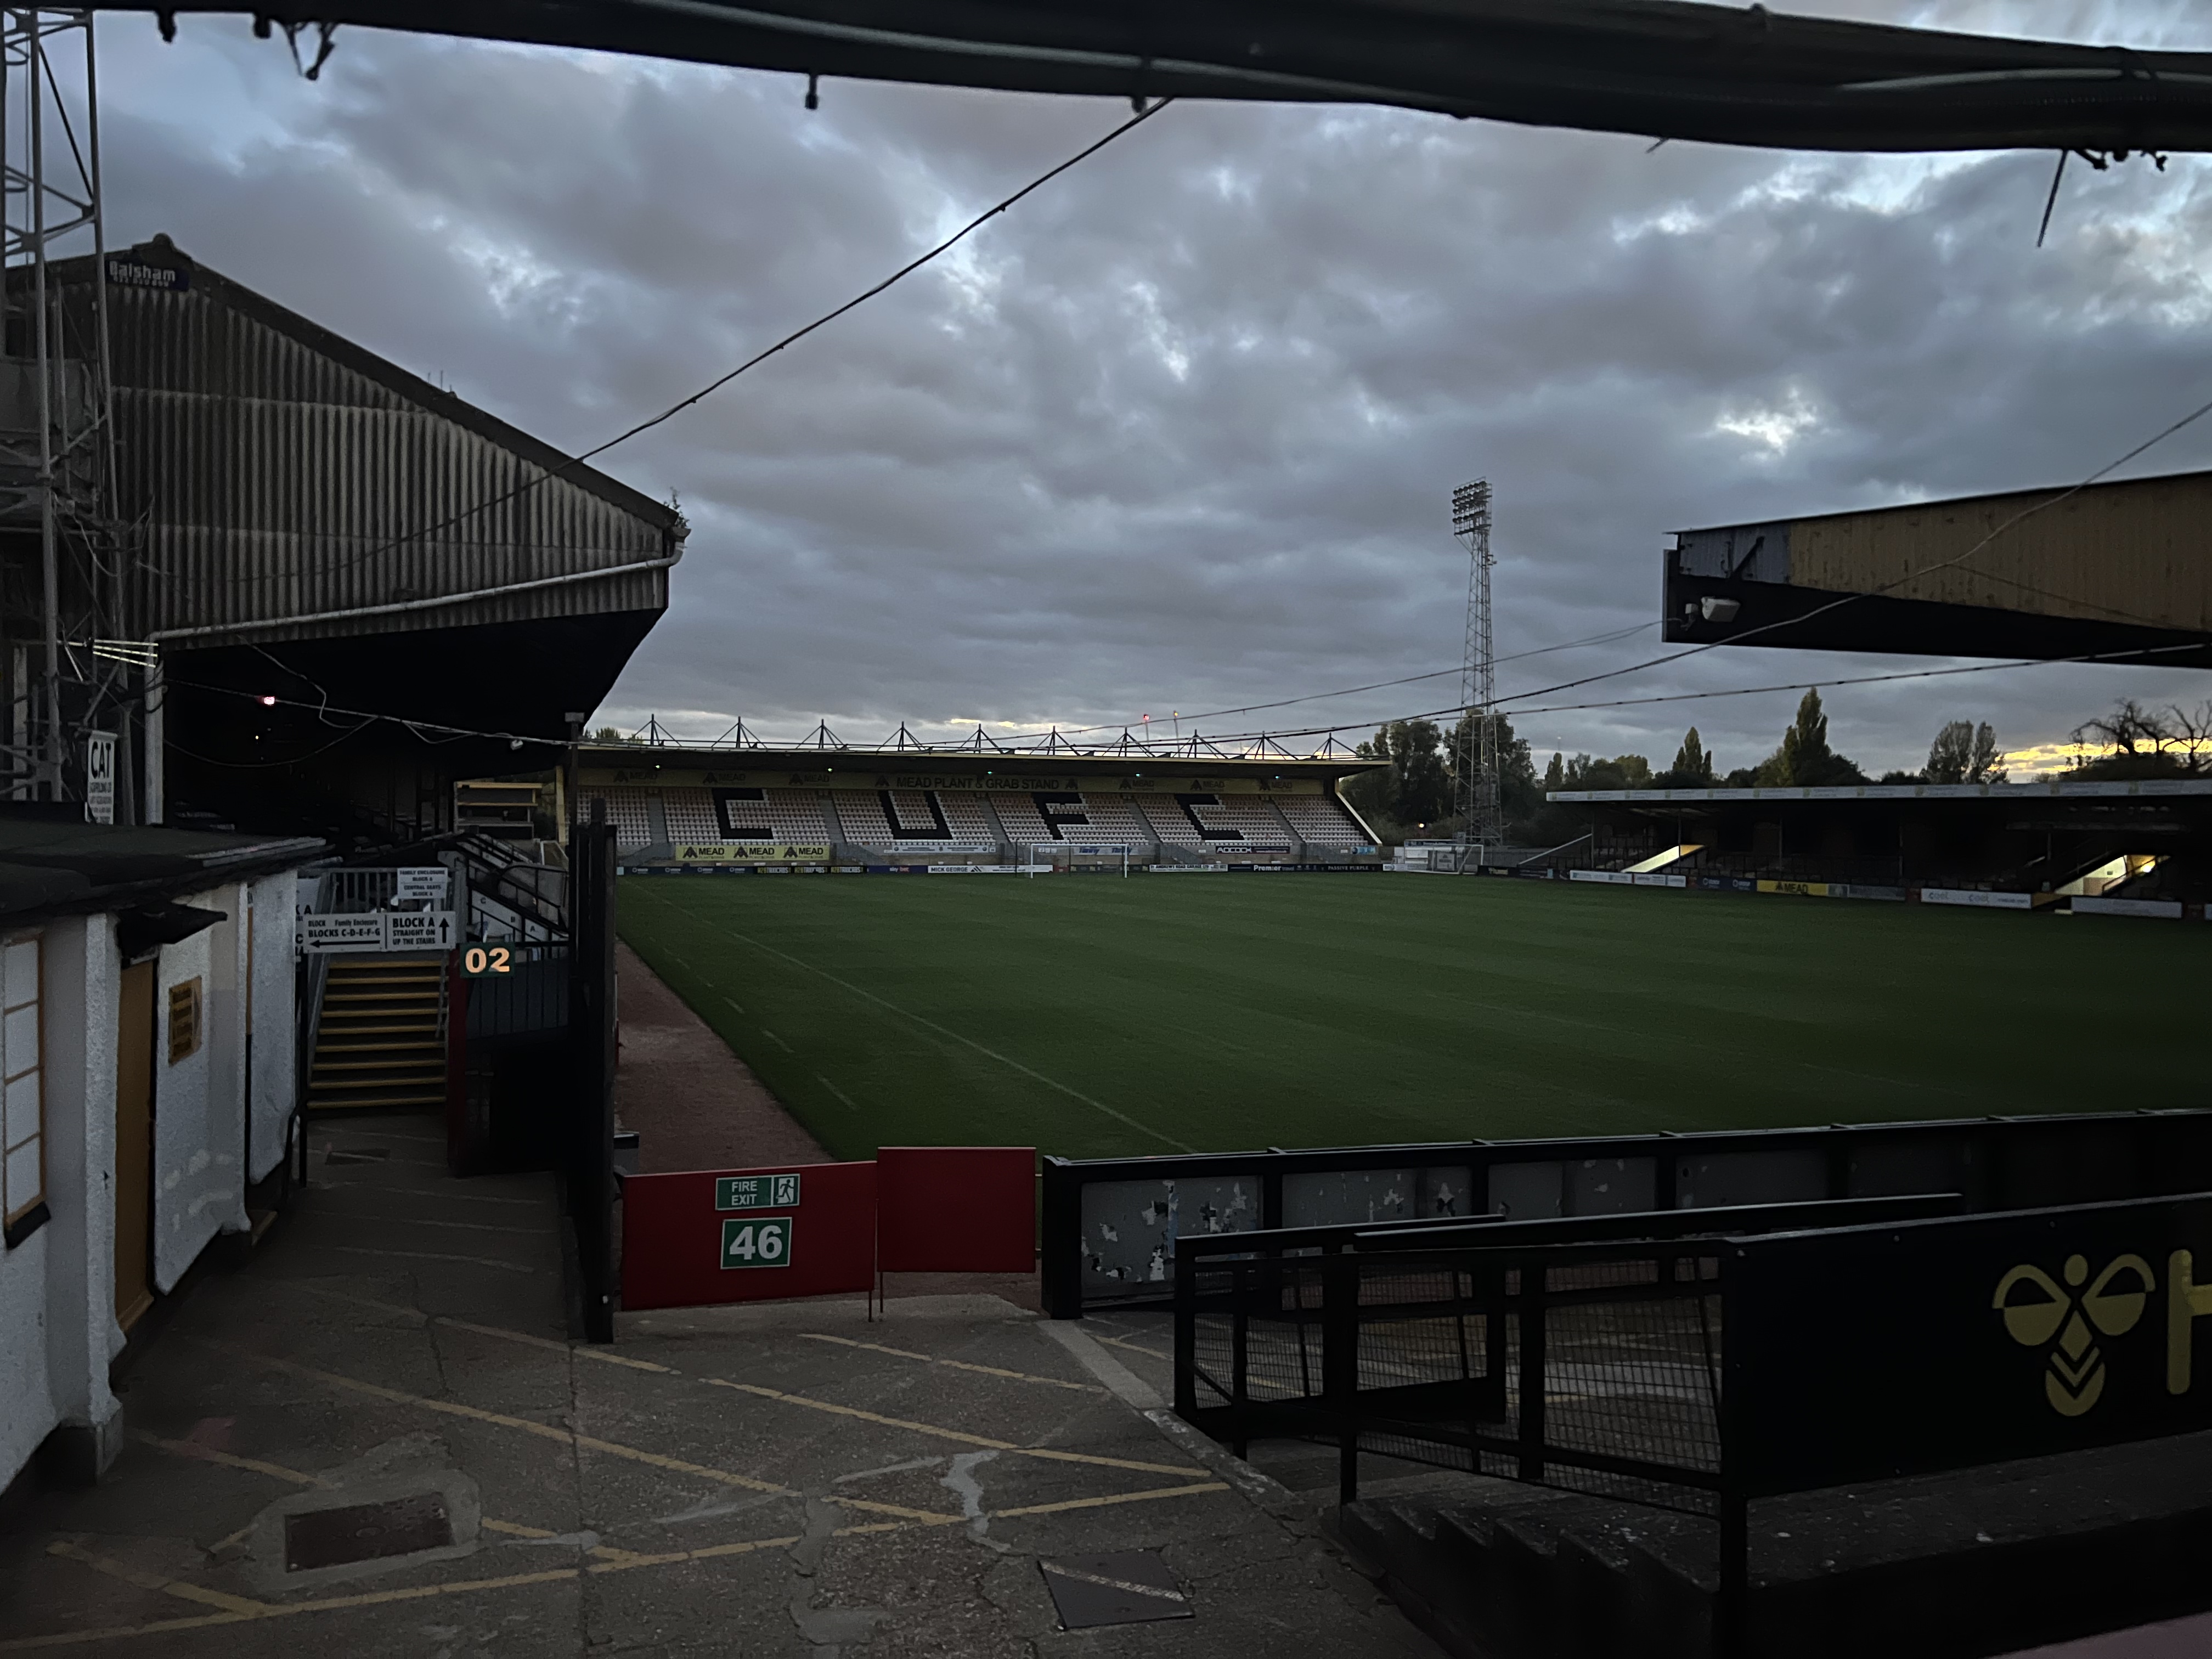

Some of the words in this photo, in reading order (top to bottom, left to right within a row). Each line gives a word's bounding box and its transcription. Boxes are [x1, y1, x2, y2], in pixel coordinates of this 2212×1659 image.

[110, 261, 176, 282] Balsham
[92, 741, 111, 779] CAT
[897, 777, 931, 788] MEAD
[934, 777, 973, 788] PLANT
[986, 778, 1019, 789] GRAB
[1022, 779, 1059, 789] STAND
[1784, 883, 1808, 894] MEAD
[335, 919, 352, 927] Family
[393, 917, 424, 928] BLOCK
[428, 917, 435, 927] A
[308, 929, 338, 938] BLOCKS
[342, 928, 380, 937] C-D-E-F-G
[465, 947, 510, 973] 02
[731, 1181, 758, 1193] FIRE
[731, 1194, 757, 1206] EXIT
[729, 1224, 782, 1260] 46
